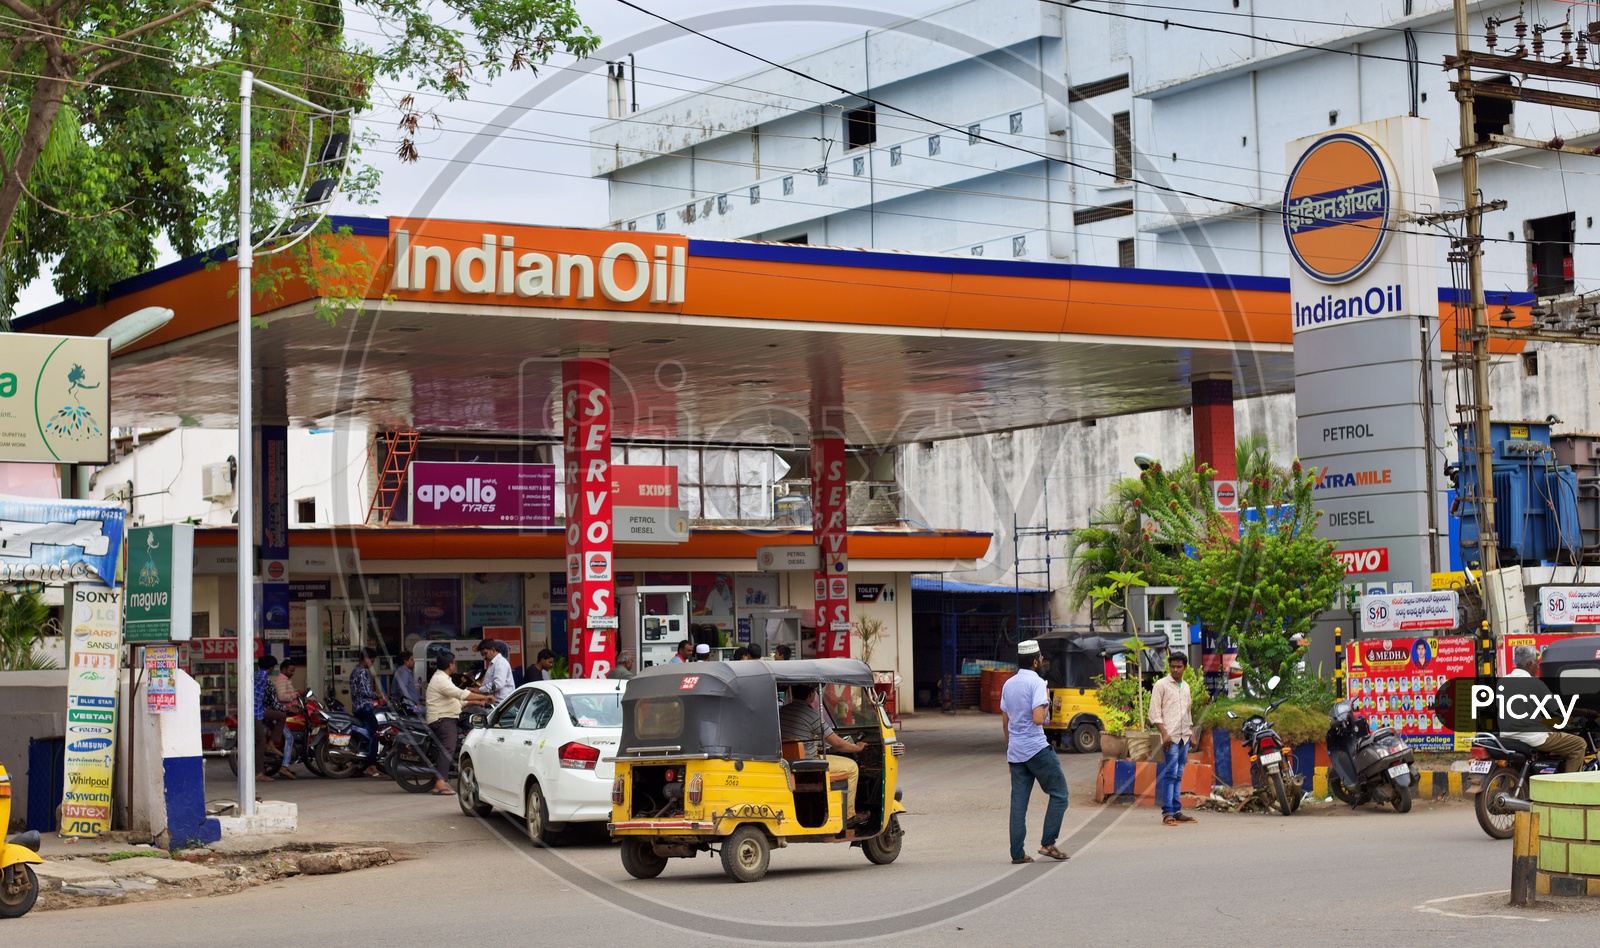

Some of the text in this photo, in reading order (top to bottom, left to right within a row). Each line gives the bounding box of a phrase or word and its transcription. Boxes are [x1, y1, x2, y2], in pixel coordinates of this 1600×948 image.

[391, 228, 686, 304] IndianOil
[1295, 284, 1402, 327] IndianOil
[1323, 424, 1374, 442] PETROL
[565, 390, 580, 546] SERVO
[585, 388, 609, 544] SERVO
[1315, 467, 1392, 490] XTRAMILE
[417, 478, 497, 510] apollo
[639, 484, 672, 496] EXIDE
[461, 503, 496, 512] TYRES
[828, 460, 844, 552] SERV
[629, 516, 656, 524] PETROL
[1329, 511, 1374, 527] DIESEL
[631, 526, 655, 534] DIESEL
[764, 555, 770, 563] 5
[1333, 550, 1381, 572] ERVO
[75, 591, 120, 603] SONY
[130, 591, 168, 611] maguva
[96, 609, 116, 620] LG
[87, 641, 119, 649] SANSUI
[1430, 640, 1437, 649] 10
[79, 653, 111, 668] IFB
[1375, 650, 1407, 660] MEDHA
[73, 741, 107, 749] SAMSUNG
[1426, 736, 1451, 744] College
[69, 776, 109, 787] Whirlpool
[69, 822, 101, 834] AOC
